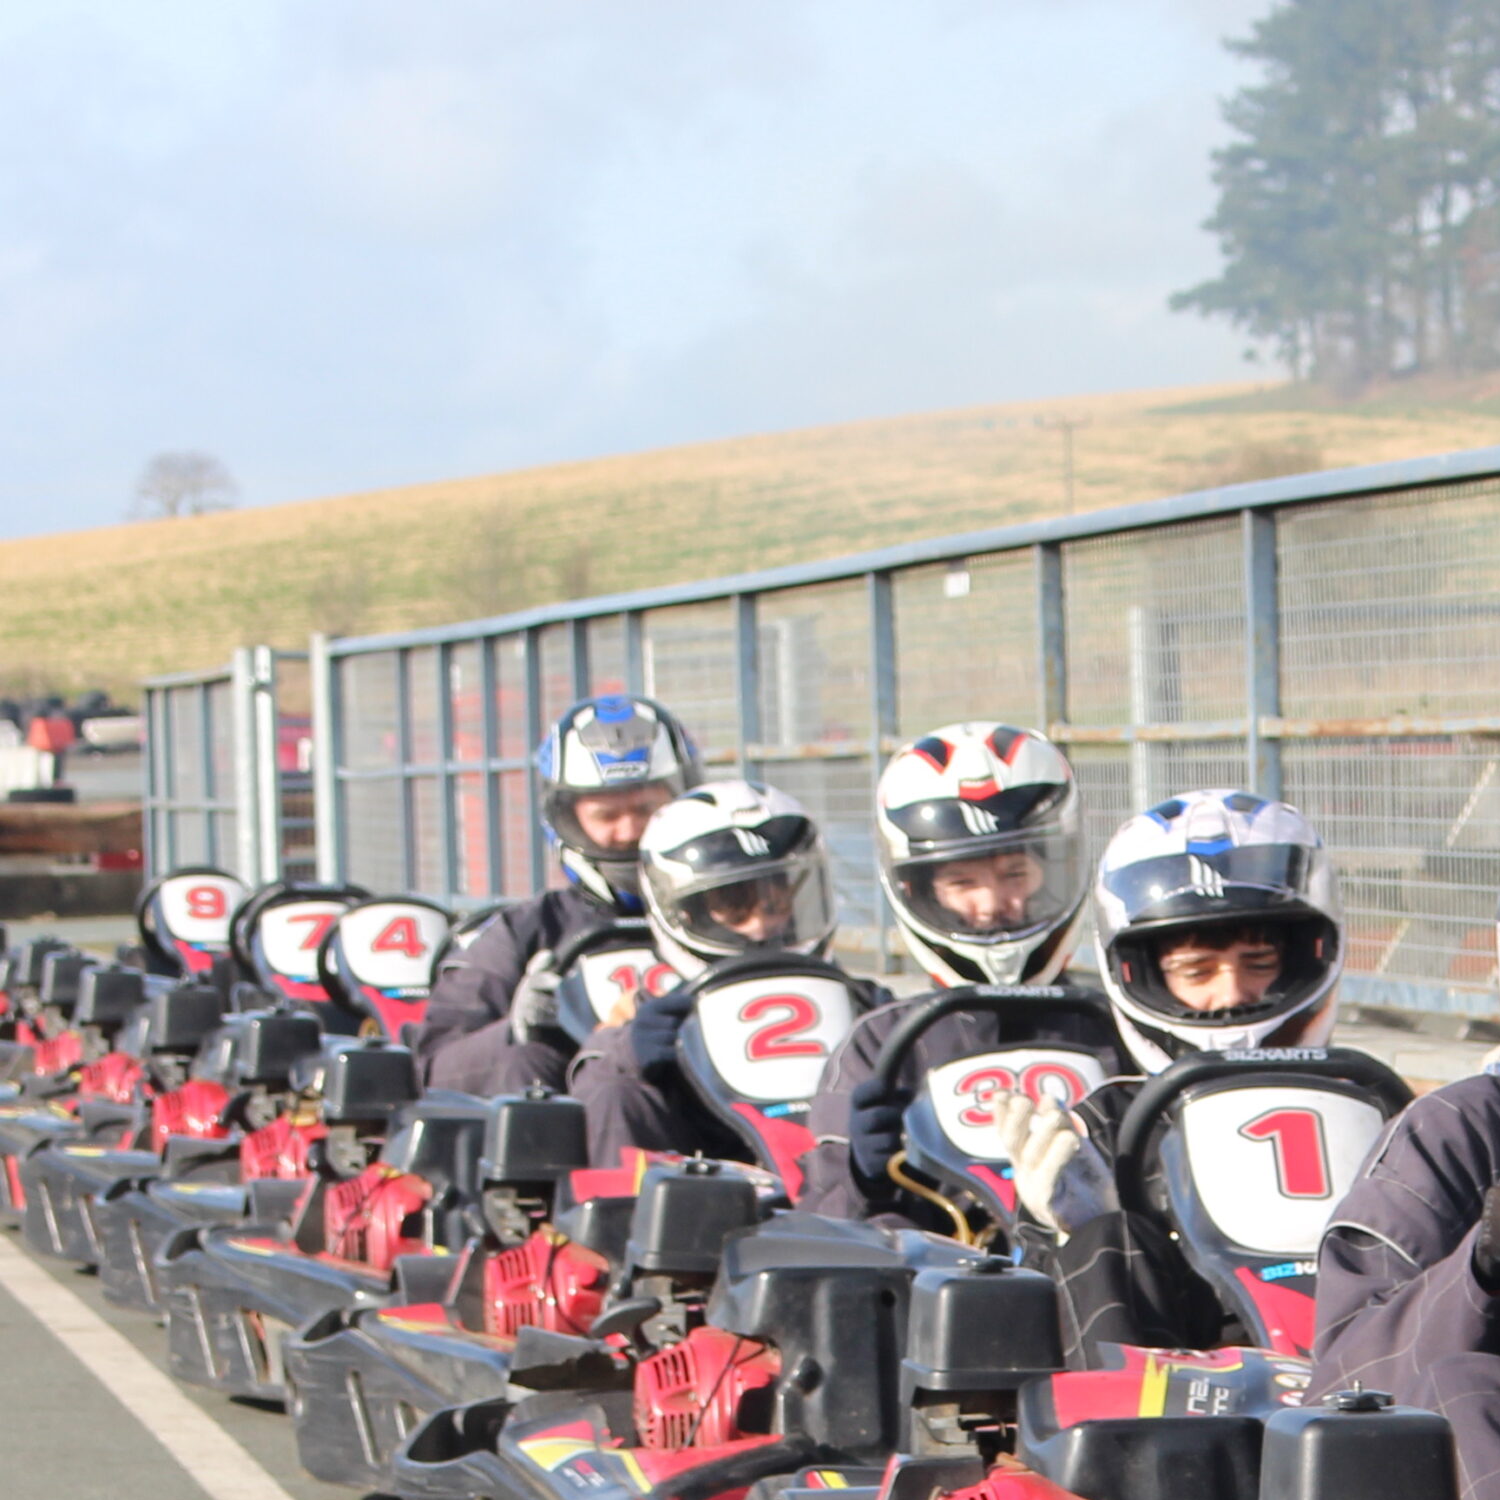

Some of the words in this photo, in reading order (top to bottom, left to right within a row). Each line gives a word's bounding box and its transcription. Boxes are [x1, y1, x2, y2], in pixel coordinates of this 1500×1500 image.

[287, 913, 336, 951] 7
[371, 916, 426, 957] 4
[738, 994, 829, 1062] 2
[1238, 1107, 1333, 1200] 1
